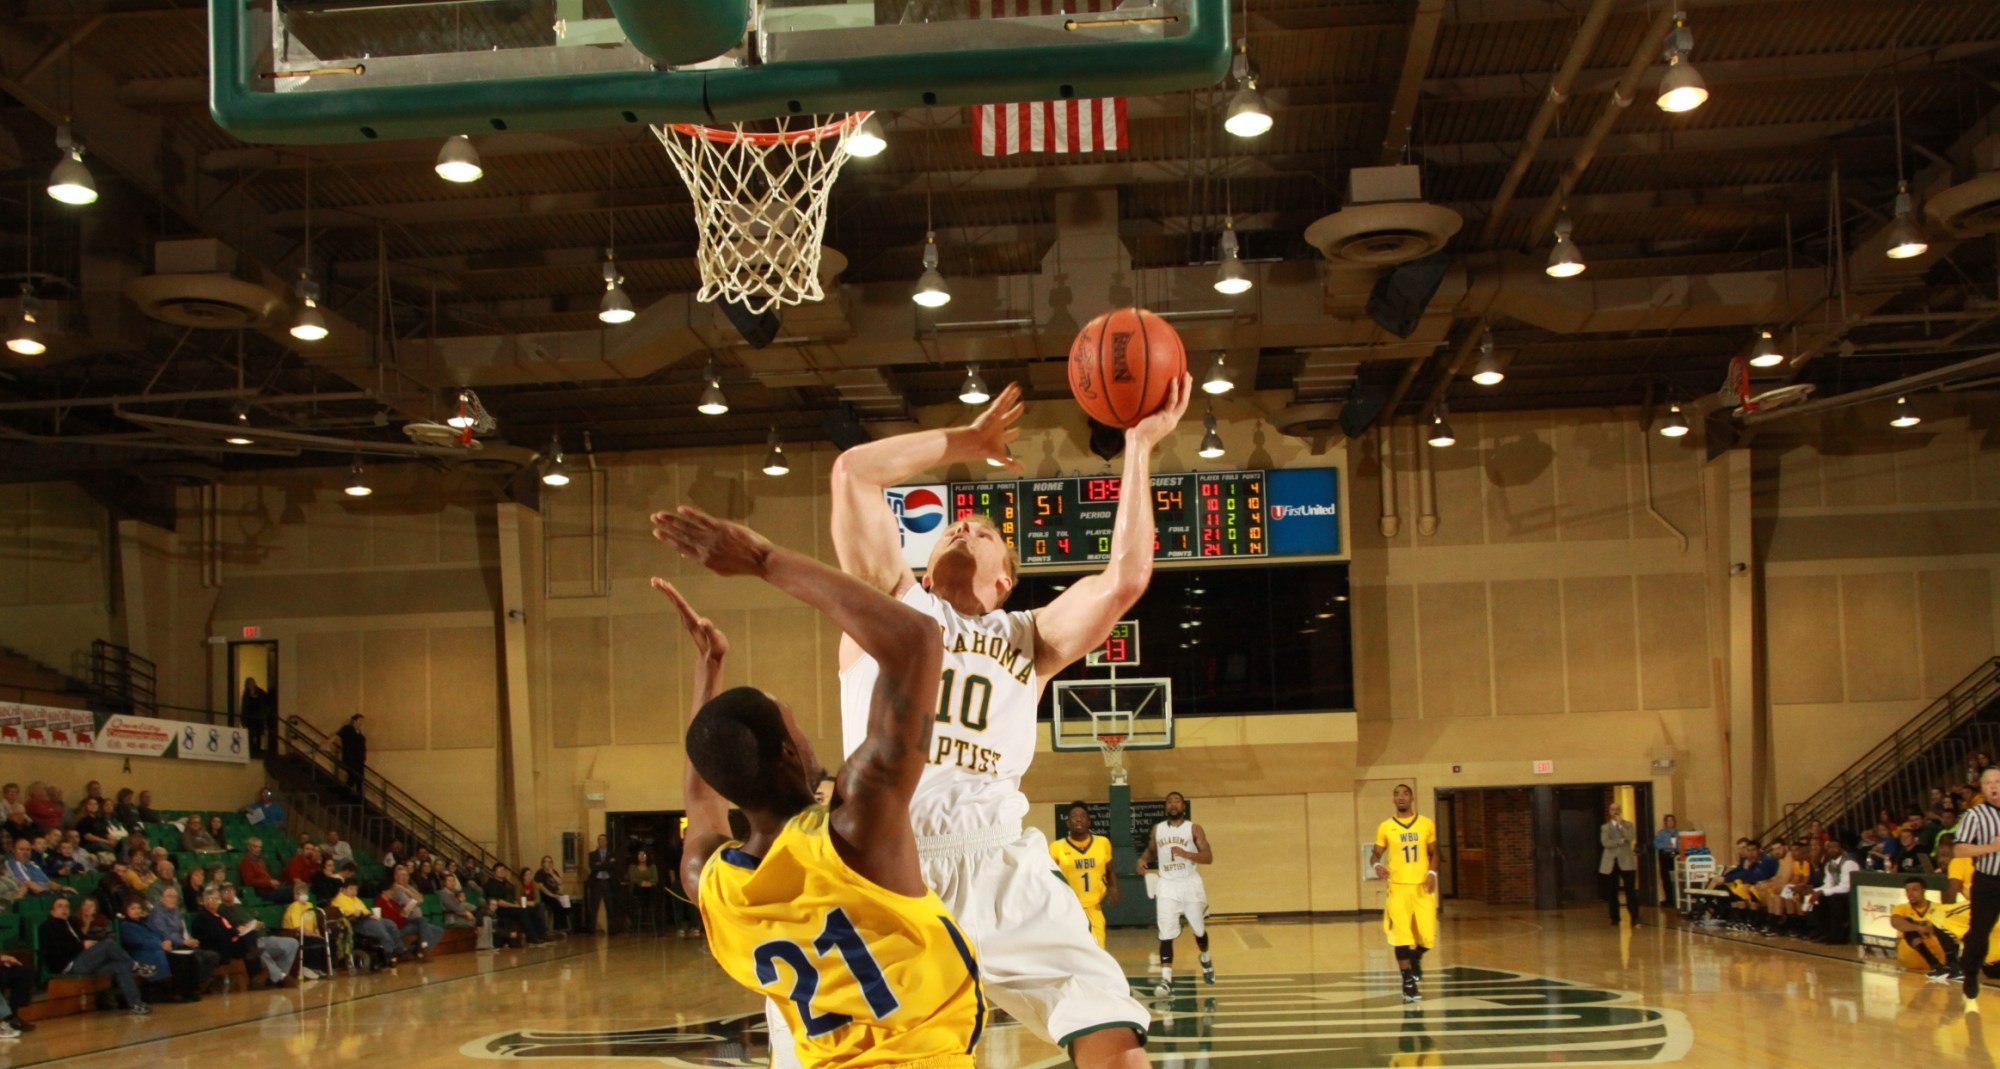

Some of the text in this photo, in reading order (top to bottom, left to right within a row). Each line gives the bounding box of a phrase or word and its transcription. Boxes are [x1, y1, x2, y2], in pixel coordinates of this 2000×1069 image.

[1033, 482, 1064, 492] HOME
[1202, 484, 1219, 497] 01
[1250, 482, 1259, 494] 4
[957, 492, 1013, 506] 01 0 7
[1037, 495, 1063, 515] 51
[1157, 491, 1183, 510] 54
[1207, 497, 1260, 511] 10 0 10
[1005, 507, 1014, 519] 8
[1080, 511, 1111, 520] PERIOD
[1207, 512, 1260, 526] 11 2 4
[1204, 528, 1220, 540] 21
[1228, 528, 1237, 540] 0
[1036, 538, 1069, 554] 0 4
[1099, 537, 1108, 552] 0
[1204, 543, 1221, 556] 24
[940, 625, 1034, 685] LAHOMA
[1106, 639, 1125, 661] 13
[935, 668, 993, 732] 10
[926, 736, 1002, 775] PTIST
[123, 757, 131, 774] A
[1400, 832, 1419, 843] WBU
[1402, 845, 1418, 863] 11
[1074, 858, 1096, 870] WBU
[1081, 872, 1090, 892] 1
[753, 906, 900, 1038] 21
